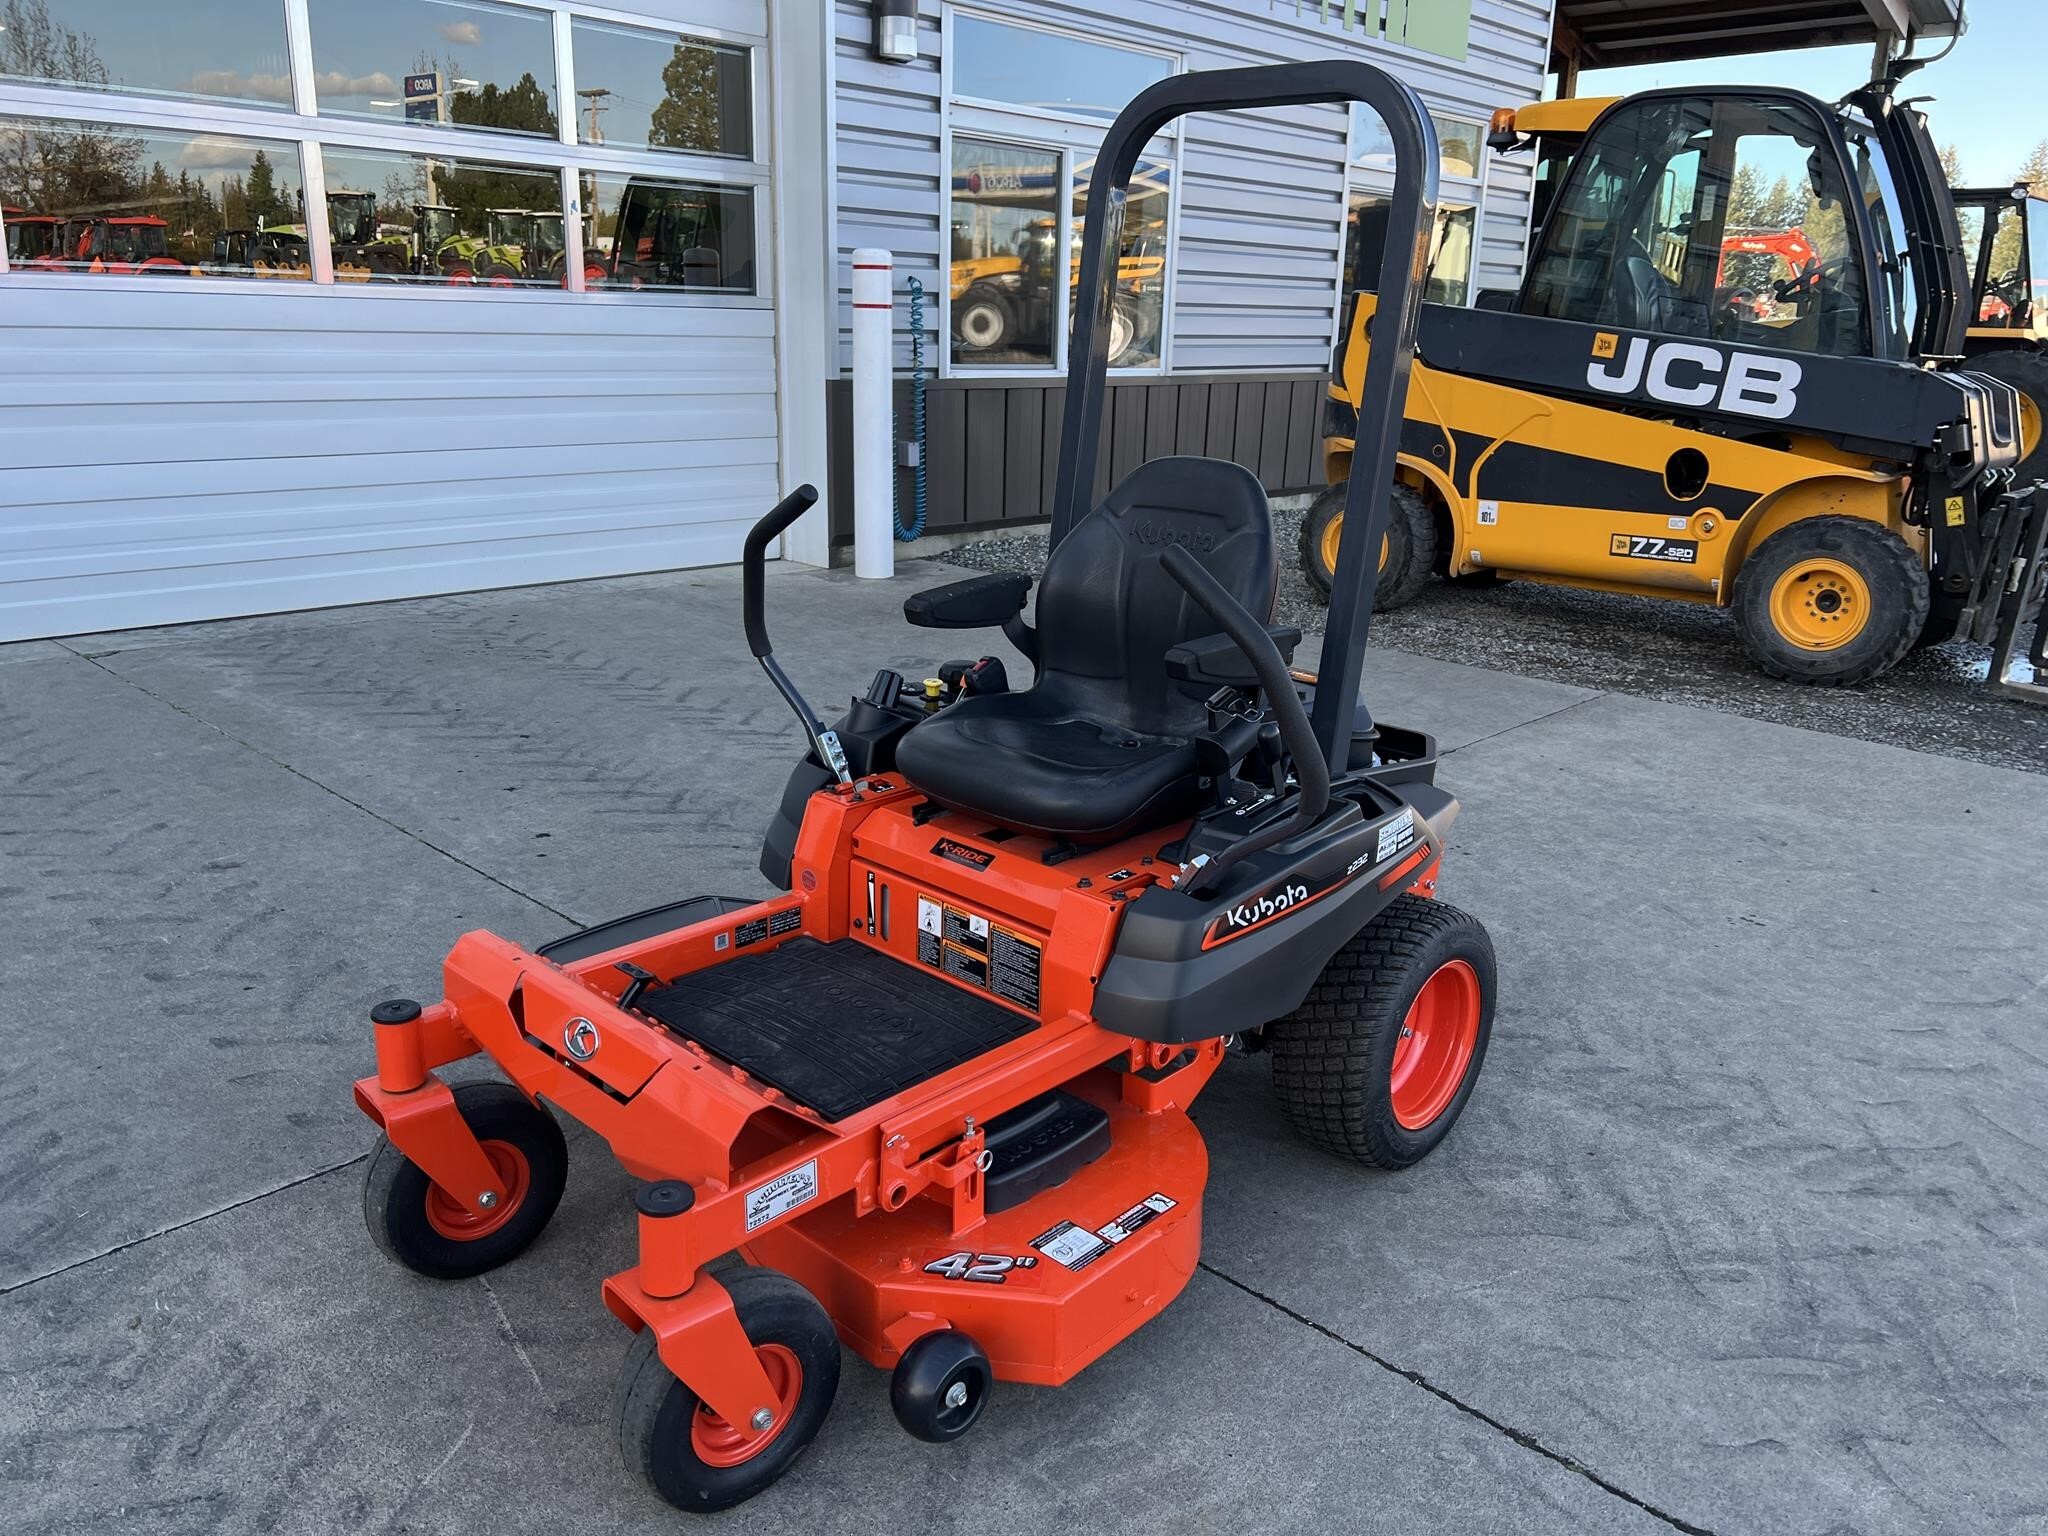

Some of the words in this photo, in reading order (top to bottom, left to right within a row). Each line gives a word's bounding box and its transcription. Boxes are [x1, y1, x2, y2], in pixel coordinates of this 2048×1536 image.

[1587, 337, 1802, 419] JCB
[940, 842, 988, 864] K-RIDE
[1227, 885, 1308, 927] Kubota
